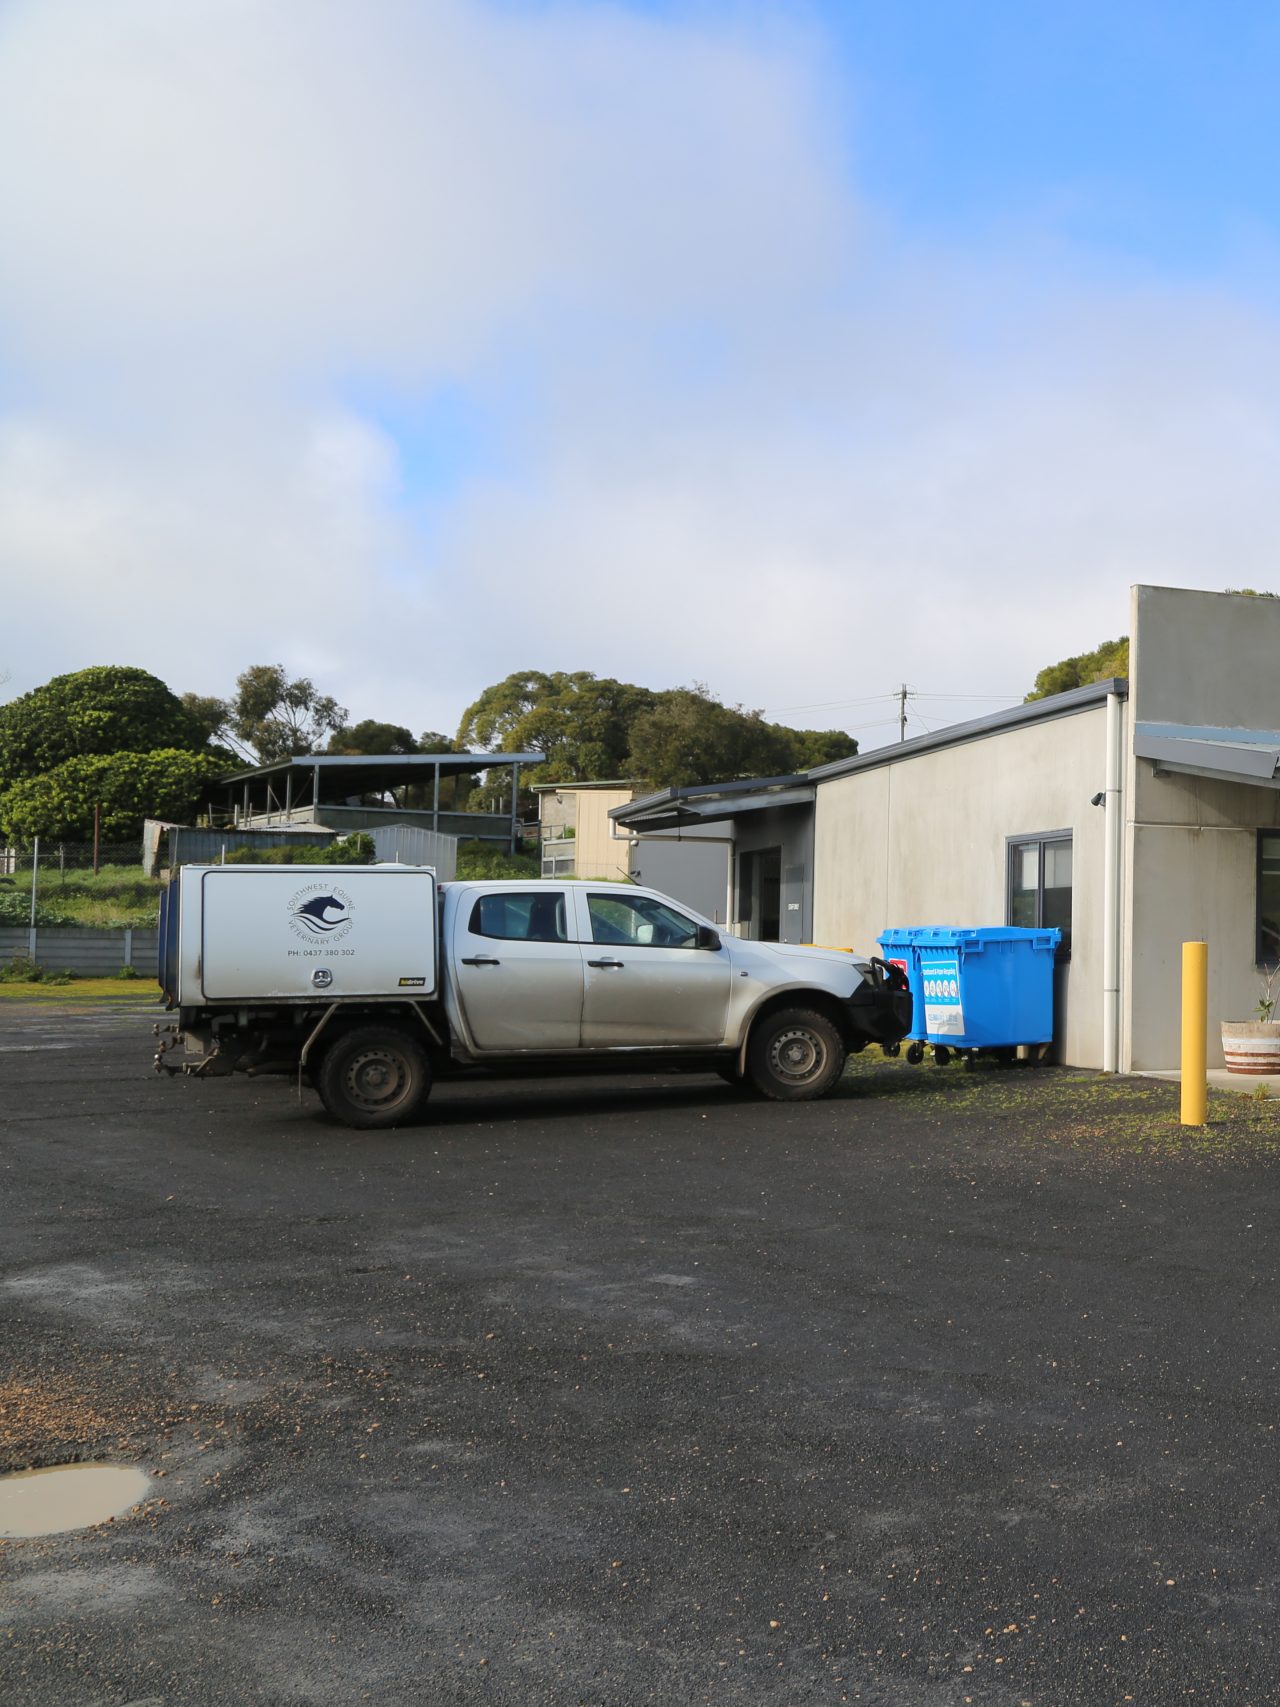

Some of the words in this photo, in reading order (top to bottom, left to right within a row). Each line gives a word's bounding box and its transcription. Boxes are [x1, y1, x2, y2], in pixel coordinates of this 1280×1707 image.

[287, 883, 329, 911] SOUTHWEST
[332, 886, 355, 911] EQUINE
[287, 919, 331, 945] VETERINARY
[324, 949, 339, 957] 380
[341, 949, 355, 957] 302
